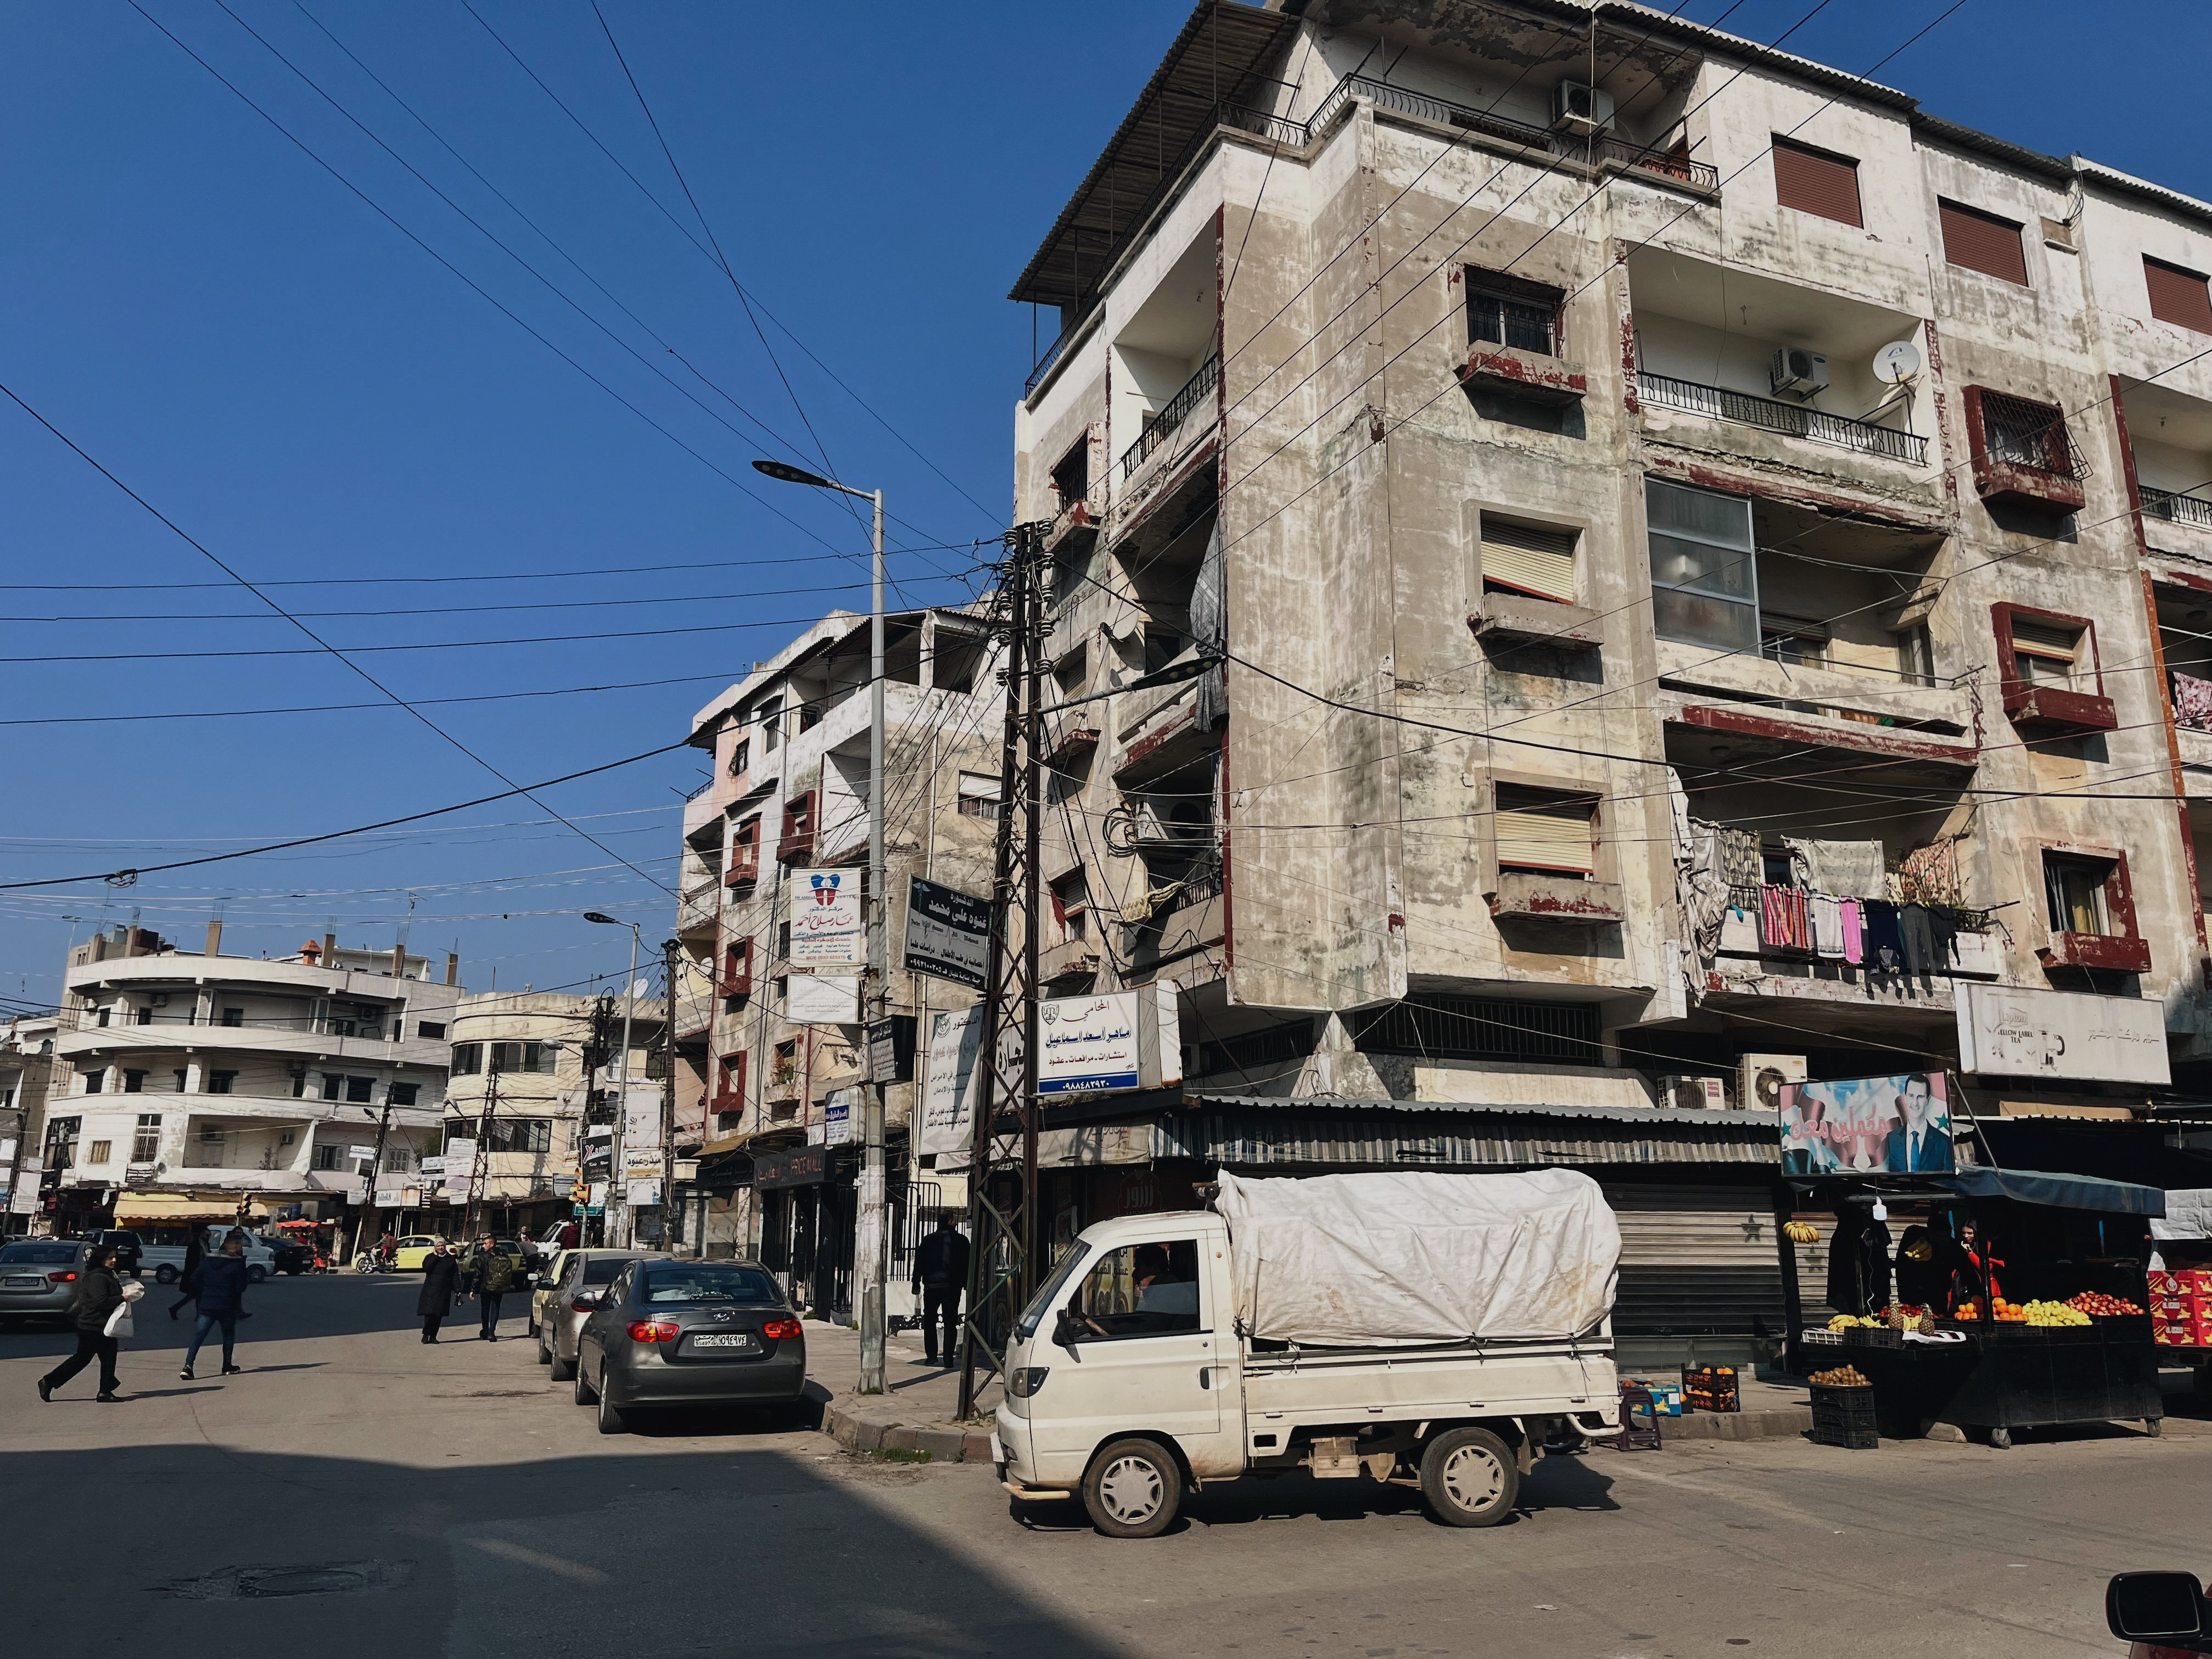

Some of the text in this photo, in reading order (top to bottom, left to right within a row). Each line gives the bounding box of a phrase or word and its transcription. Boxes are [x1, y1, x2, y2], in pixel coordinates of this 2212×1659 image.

[929, 899, 950, 916] محمد
[952, 908, 967, 925] علي
[1061, 999, 1109, 1022] المحامي
[953, 1016, 980, 1030] الدكتور
[1106, 1027, 1132, 1043] ماهر
[1049, 1051, 1127, 1066] استشارات مرافعات عقود
[1112, 1262, 1128, 1279] عشق
[721, 1336, 746, 1344] ٥٩٤٩٧٤
